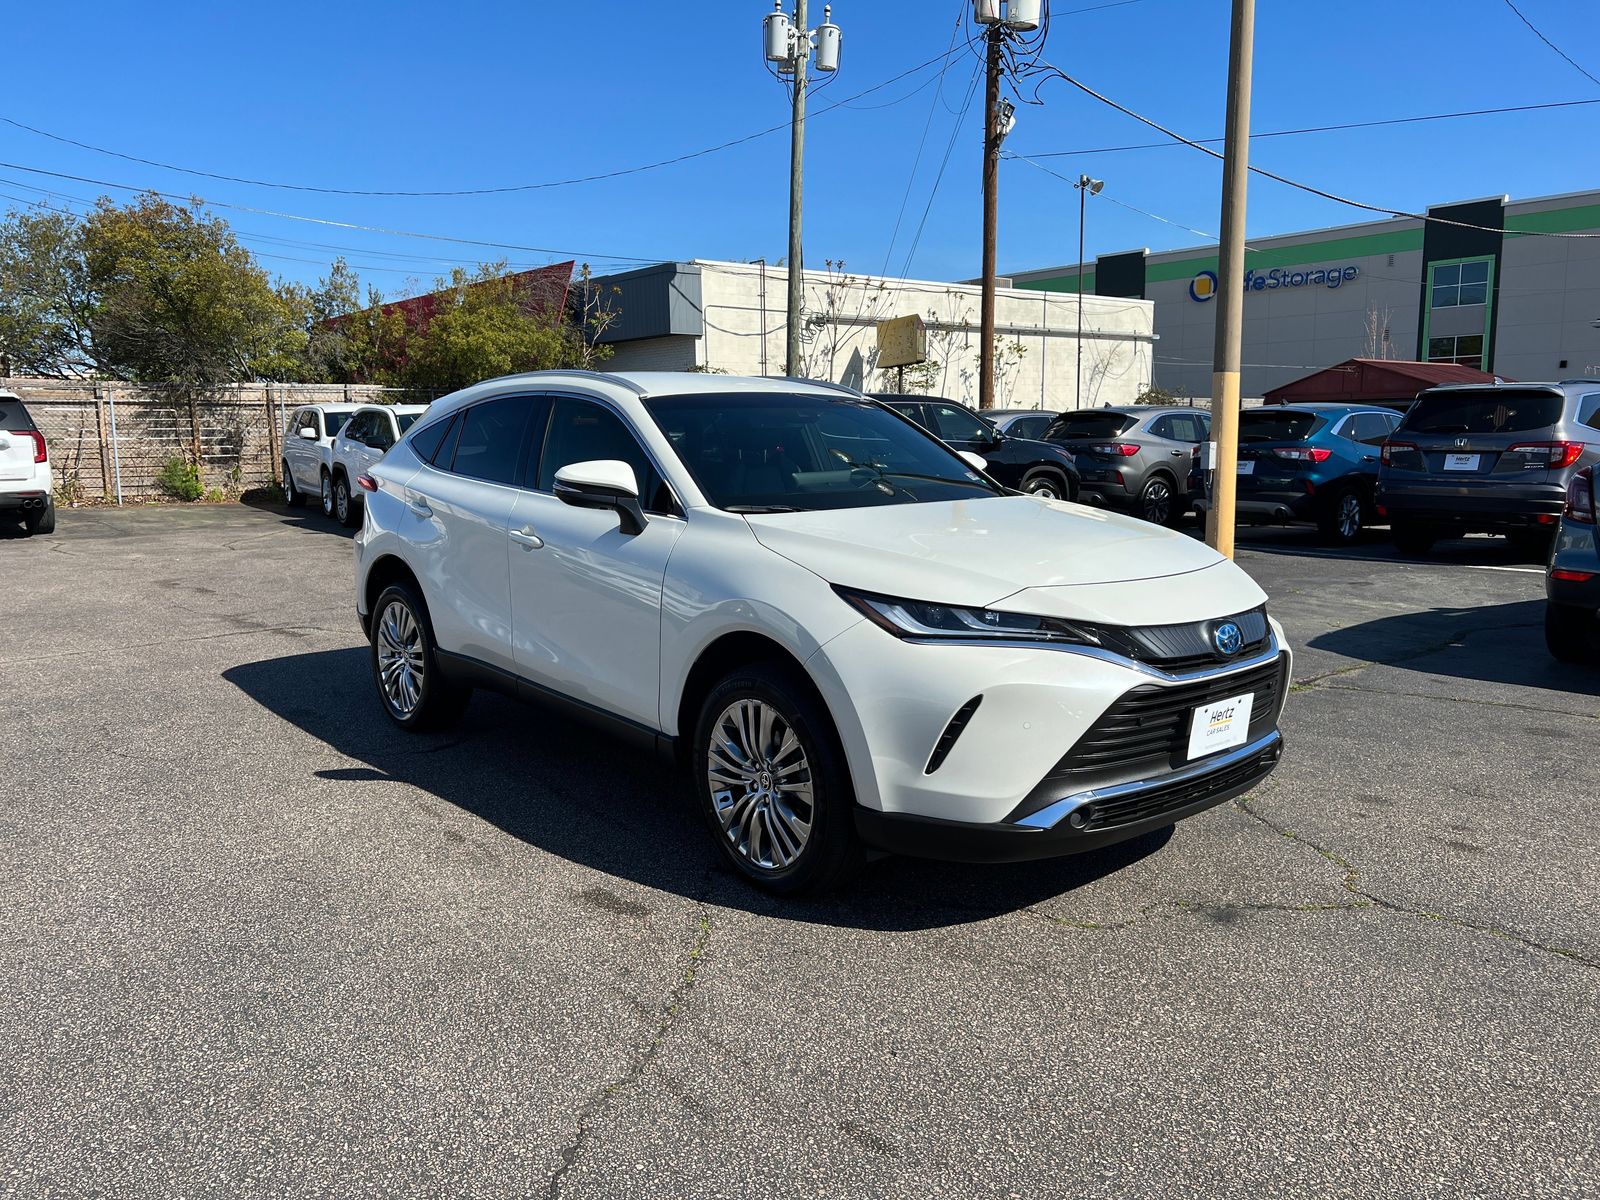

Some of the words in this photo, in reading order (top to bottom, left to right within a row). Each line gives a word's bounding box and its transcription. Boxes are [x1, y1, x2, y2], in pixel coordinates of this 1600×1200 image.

[1244, 265, 1359, 291] feStorage
[1209, 706, 1234, 723] Hertz
[1206, 728, 1216, 736] CAR
[1216, 724, 1230, 734] SALES
